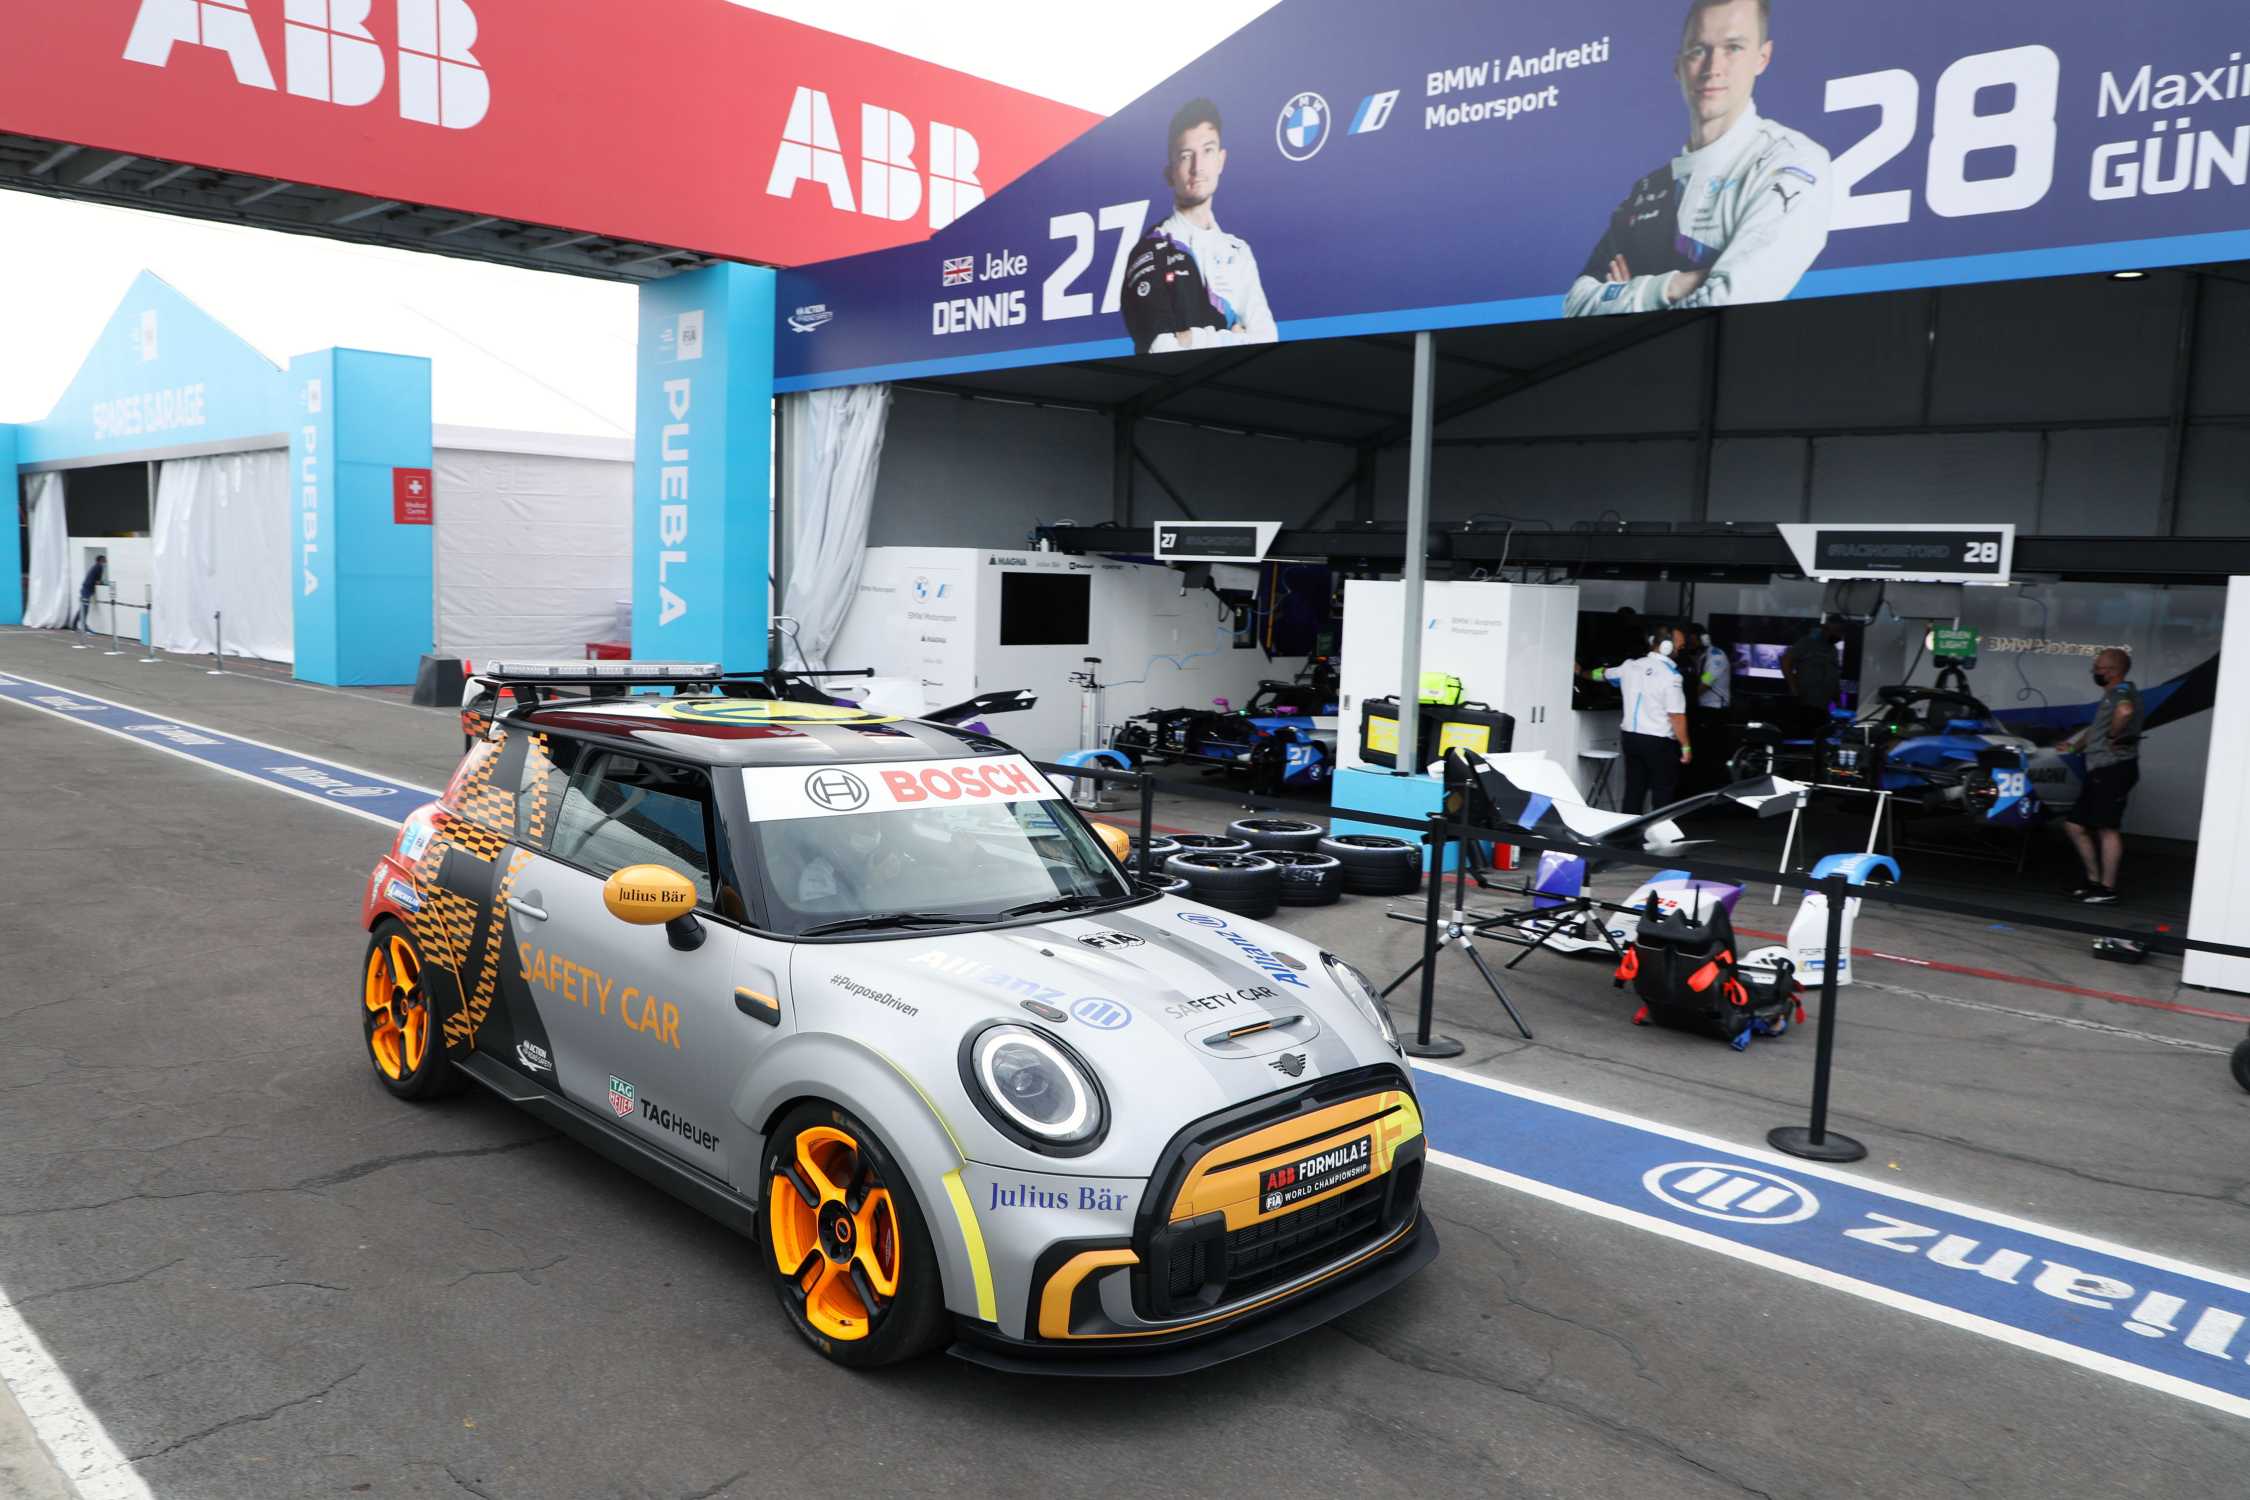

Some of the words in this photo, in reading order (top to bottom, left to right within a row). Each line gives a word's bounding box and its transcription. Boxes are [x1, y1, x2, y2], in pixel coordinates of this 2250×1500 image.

[121, 0, 490, 129] ABB
[1426, 62, 1488, 97] BMW
[1493, 60, 1501, 83] i
[1505, 37, 1610, 80] Andretti
[2097, 52, 2250, 118] Maxi
[1284, 96, 1325, 119] BMW
[1424, 86, 1559, 130] Motorsport
[765, 85, 987, 230] ABB
[1824, 44, 2060, 232] 28
[2089, 116, 2250, 201] GÜN
[979, 249, 1028, 282] Jake
[1042, 200, 1150, 321] 27
[932, 290, 1027, 335] DENNIS
[303, 426, 320, 597] PUEBLA
[658, 377, 691, 627] PUEBLA
[1160, 532, 1177, 549] 27
[1963, 542, 1999, 564] 28
[1939, 639, 1968, 650] LIGHT
[1289, 743, 1310, 765] 27
[879, 763, 1041, 804] BOSCH
[1998, 773, 2026, 797] 28
[618, 886, 657, 903] Julius
[660, 887, 687, 903] Bär
[1081, 932, 1138, 949] FIA
[1214, 930, 1310, 989] Allianz
[518, 942, 614, 1016] SAFETY
[620, 986, 682, 1051] CAR
[829, 973, 919, 1018] #PurposeDriven
[907, 950, 1067, 1006] Allianz
[1165, 992, 1237, 1019] SAFETY
[1237, 986, 1279, 1001] CAR
[608, 1091, 635, 1116] HEUER
[611, 1077, 634, 1098] TAG
[1266, 1192, 1283, 1209] FIA
[1284, 1185, 1312, 1202] WORLD
[1314, 1163, 1368, 1191] CHAMPIONSHIP
[1267, 1167, 1296, 1191] ABB
[1298, 1146, 1358, 1180] FORMULA
[1360, 1139, 1369, 1157] E
[989, 1182, 1069, 1212] Julius
[1077, 1184, 1129, 1212] Bär
[1843, 1212, 2250, 1366] lianz
